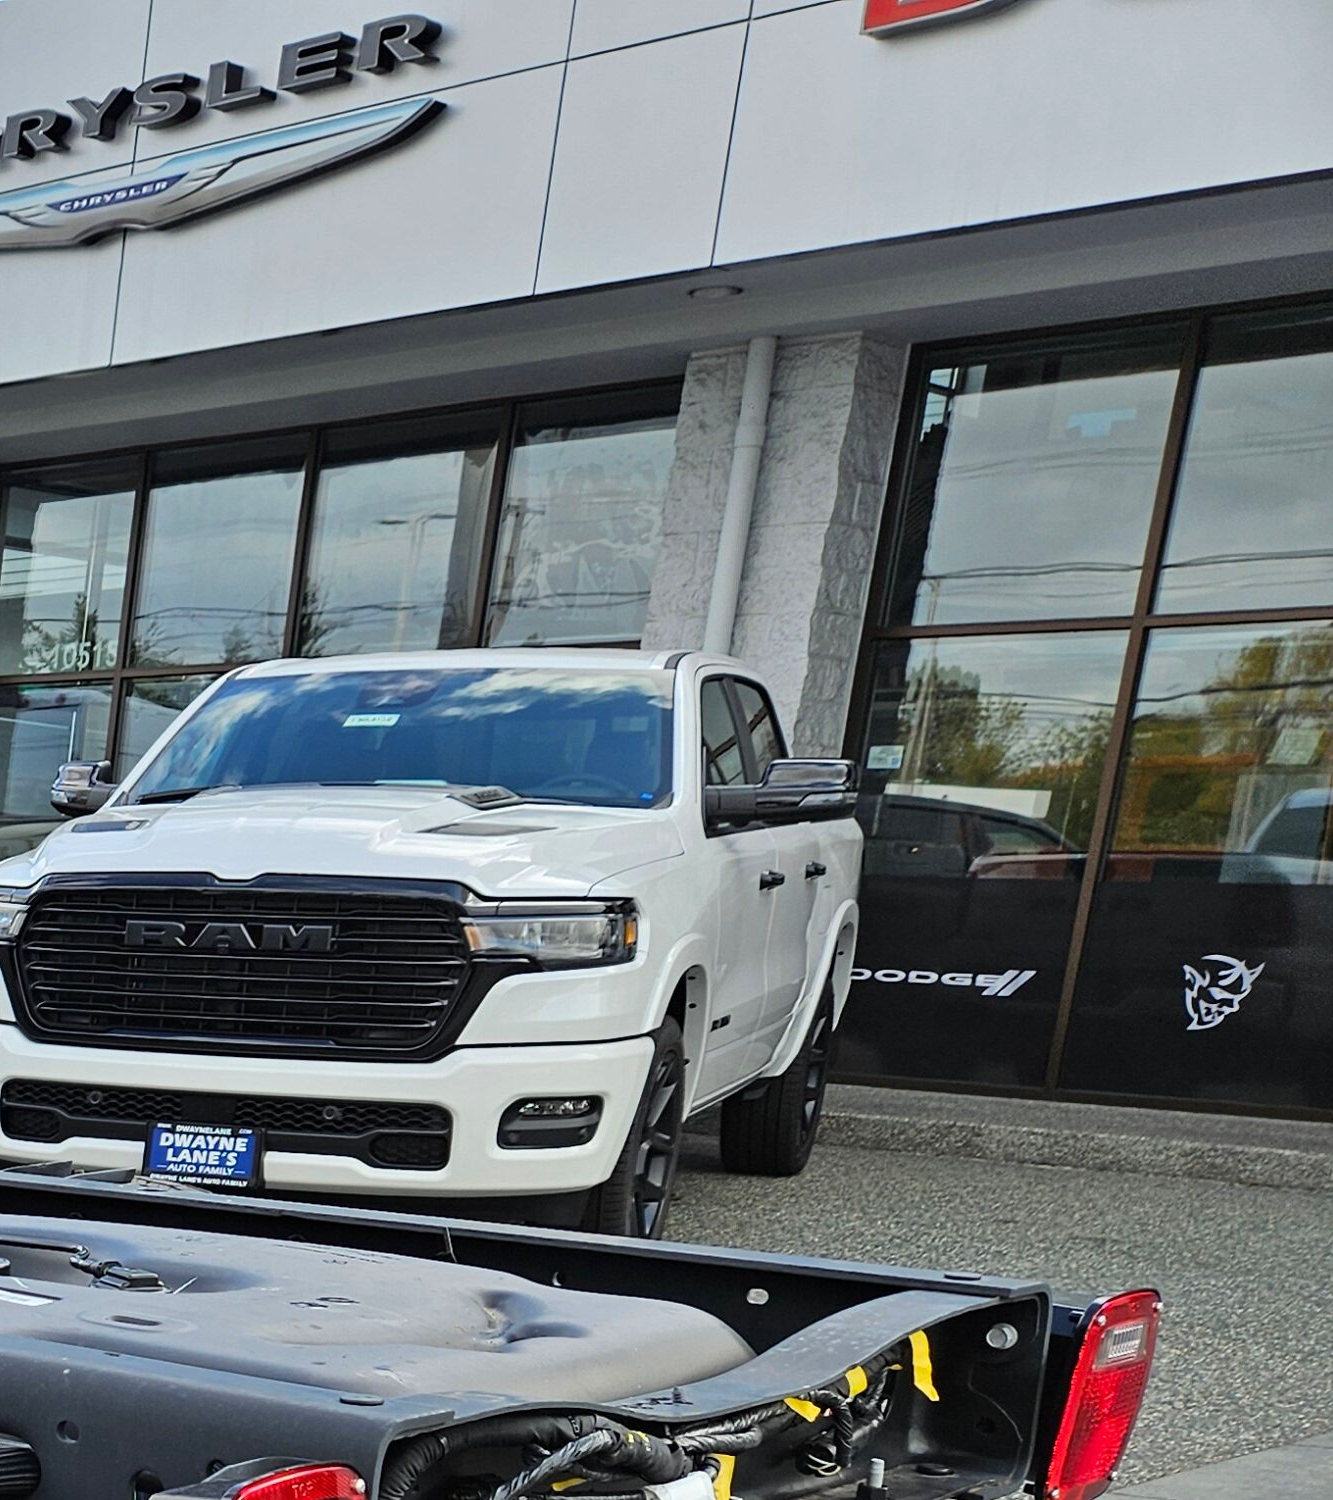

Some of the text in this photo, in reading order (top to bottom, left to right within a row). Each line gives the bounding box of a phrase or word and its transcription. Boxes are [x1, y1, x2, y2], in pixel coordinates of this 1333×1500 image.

[59, 181, 168, 212] CHRYSLER
[125, 919, 333, 952] RAM
[851, 968, 1004, 987] DODGE
[159, 1132, 248, 1152] DWAYNE
[166, 1148, 238, 1167] LANE'S
[166, 1163, 235, 1176] AUTO FAMILY
